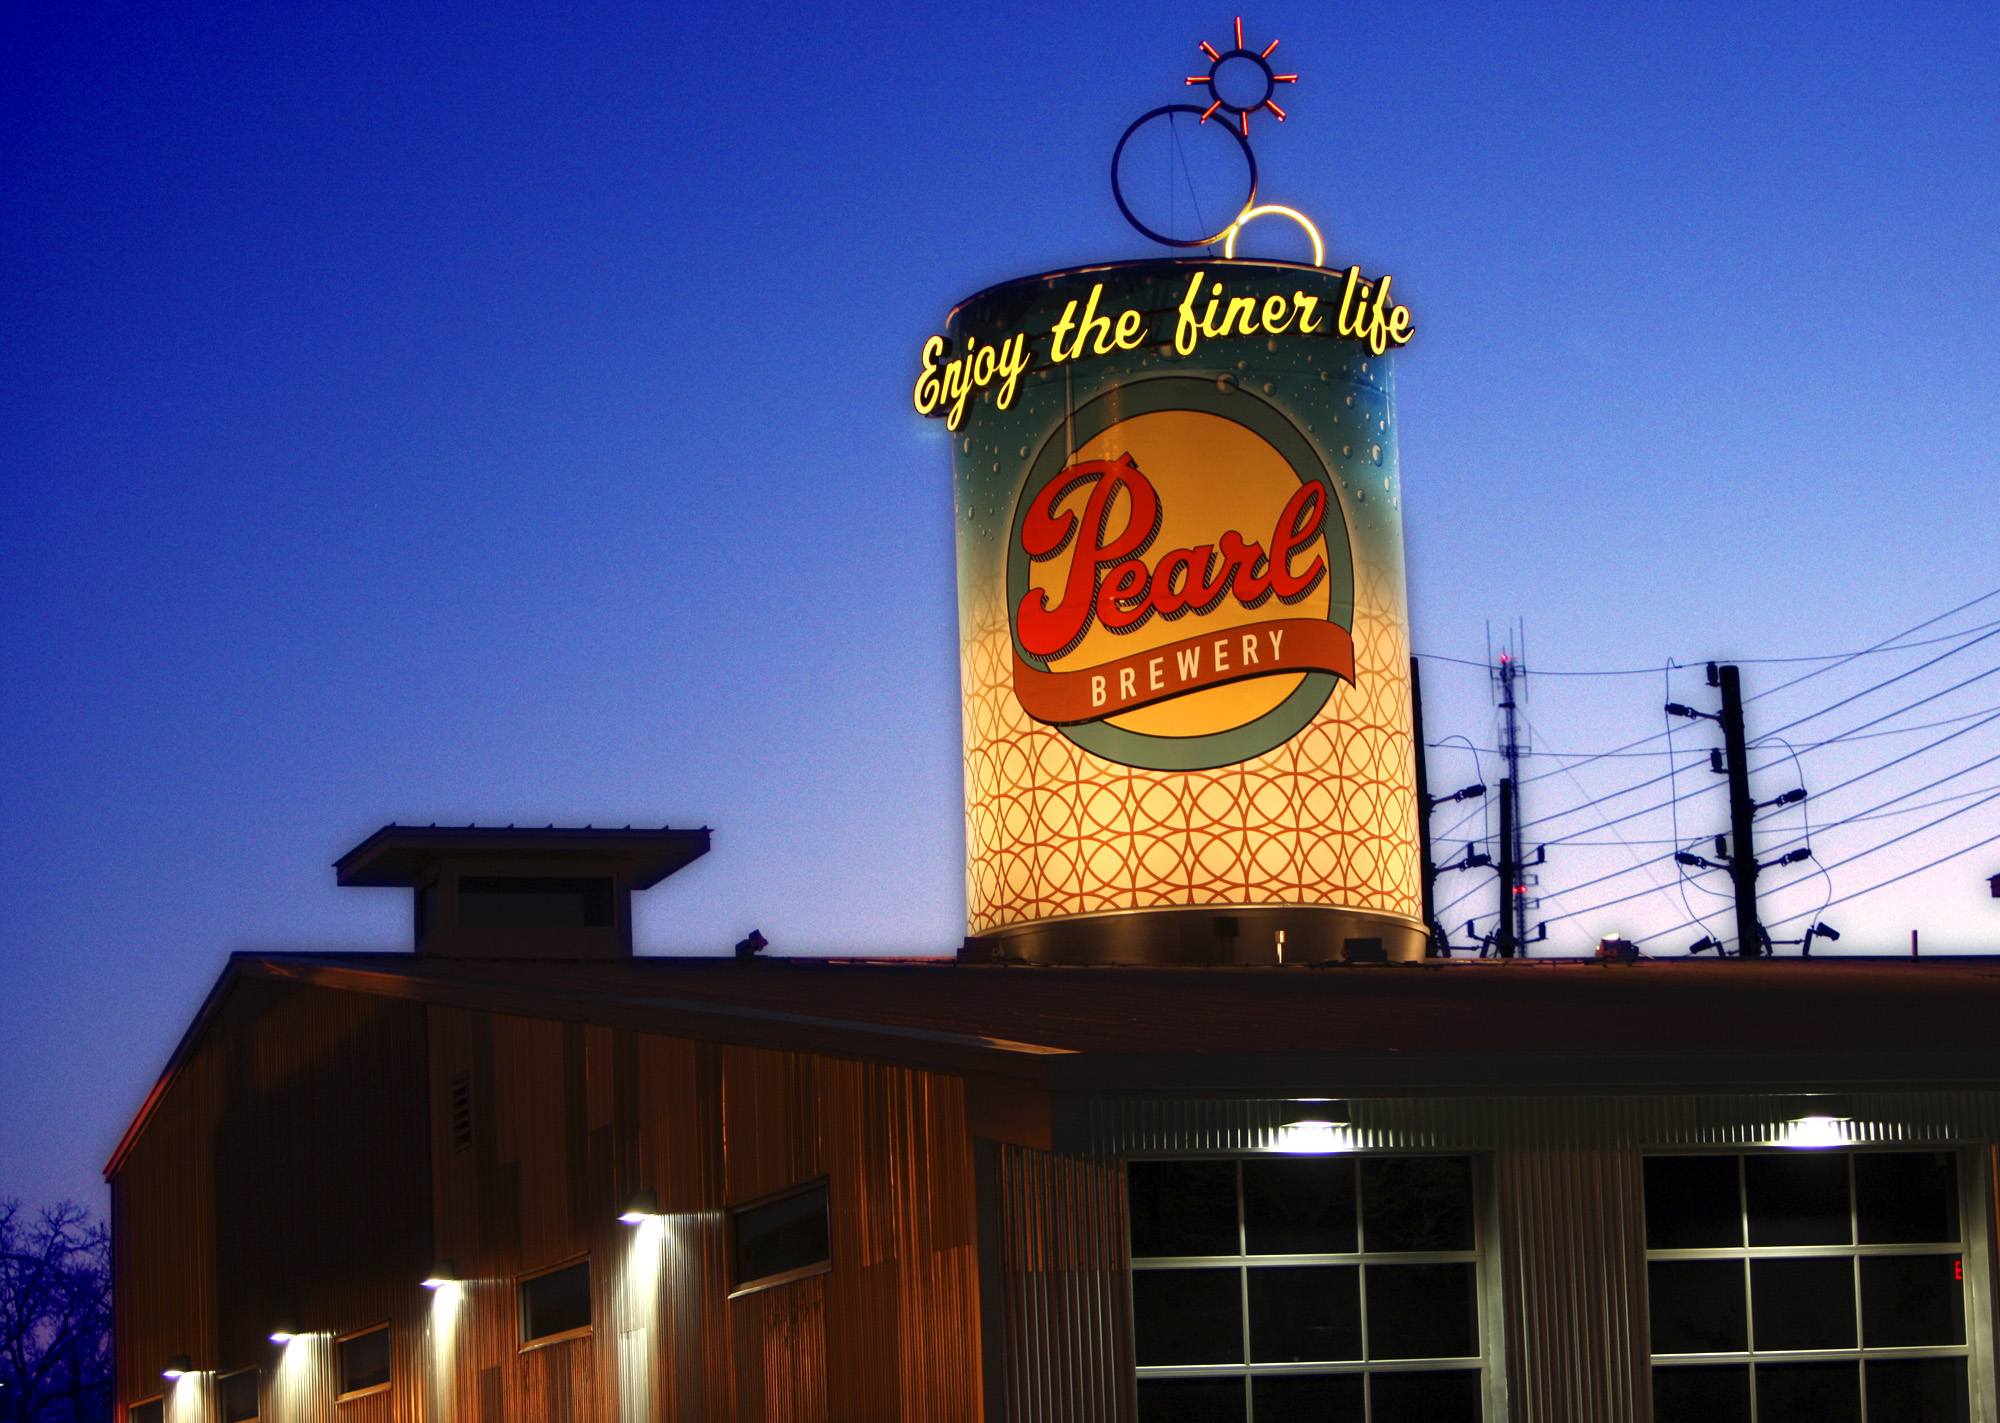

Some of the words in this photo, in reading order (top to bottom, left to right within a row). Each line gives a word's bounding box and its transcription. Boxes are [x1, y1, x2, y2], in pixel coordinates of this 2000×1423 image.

[913, 334, 1031, 432] Enjoy
[1050, 283, 1149, 363] the
[1174, 271, 1322, 357] finer
[1337, 265, 1415, 356] life
[1017, 452, 1329, 662] Pearl
[1091, 629, 1284, 708] BREWERY
